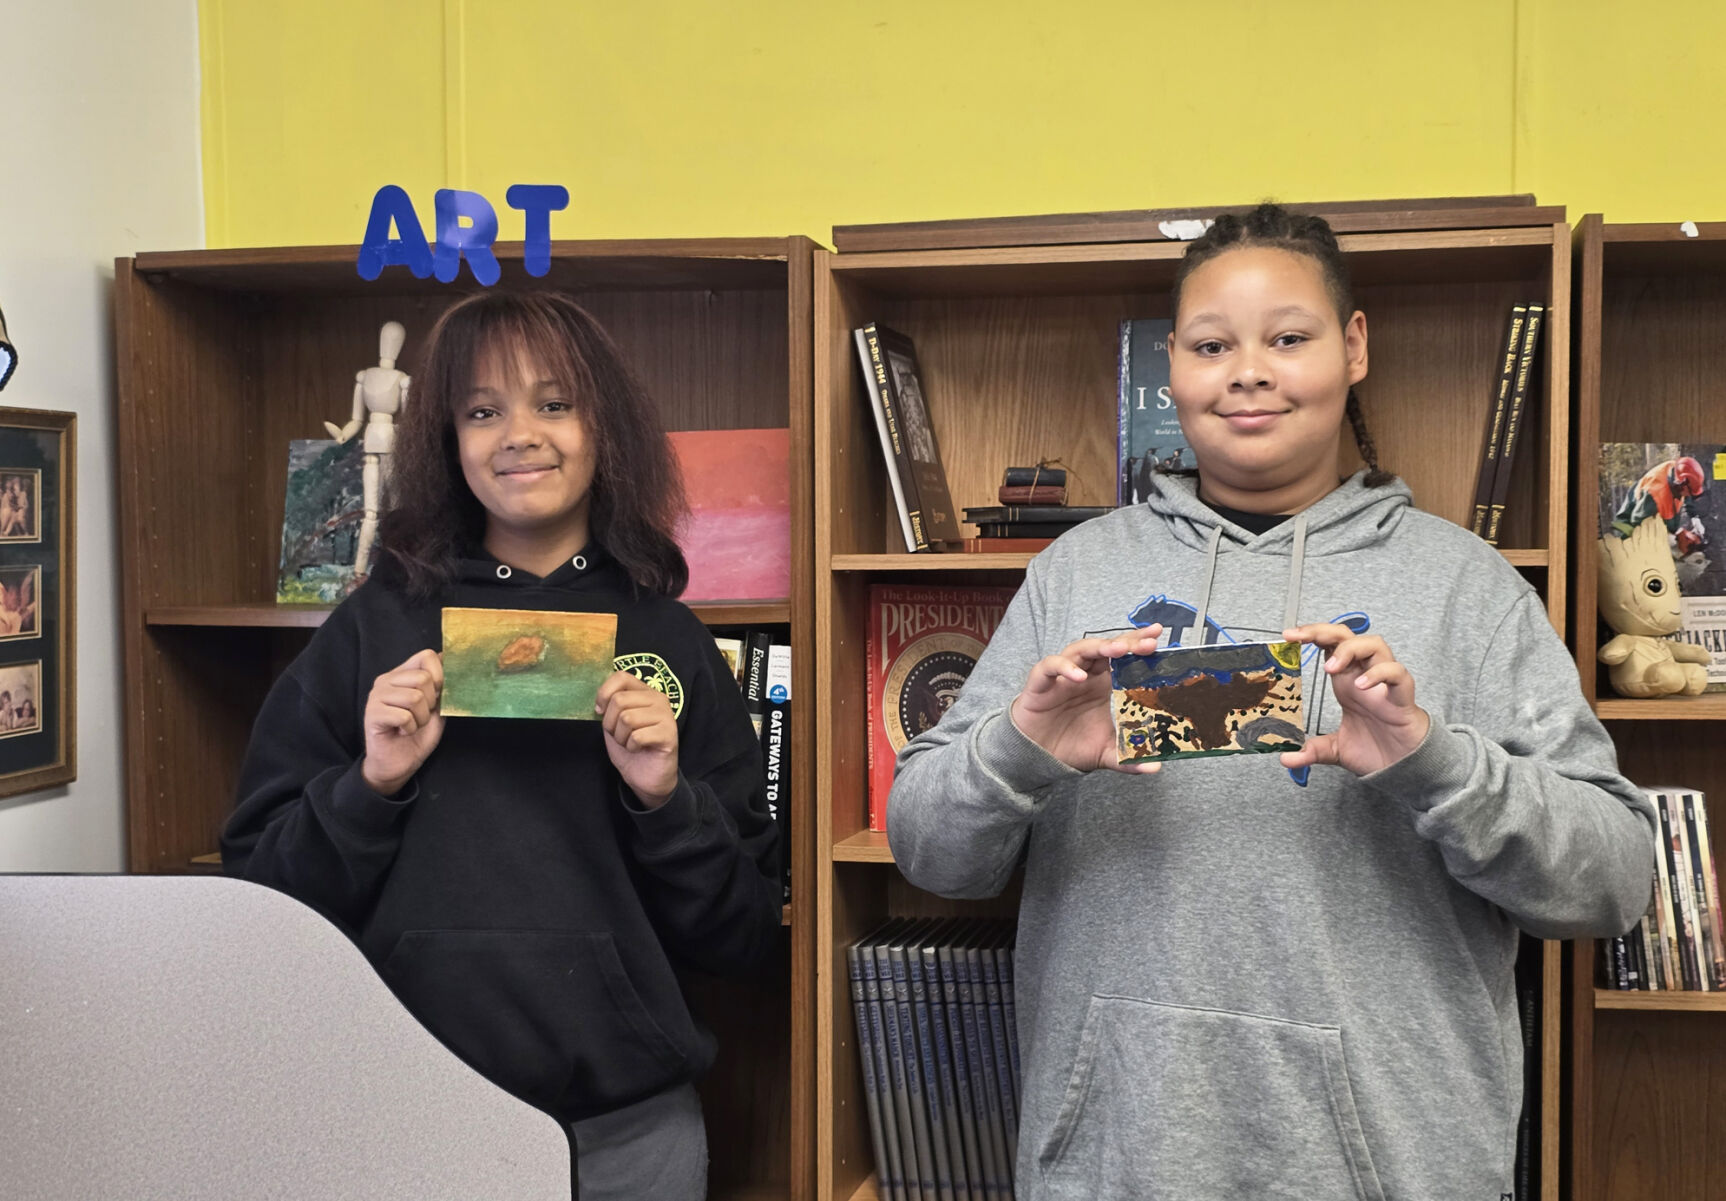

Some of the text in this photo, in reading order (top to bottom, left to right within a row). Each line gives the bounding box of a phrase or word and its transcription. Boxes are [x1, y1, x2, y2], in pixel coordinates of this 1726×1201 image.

[357, 184, 569, 286] ART
[875, 363, 886, 384] 1944
[1136, 386, 1177, 410] I S
[882, 589, 900, 600] The
[880, 602, 1003, 677] PRESIDENT
[654, 659, 679, 699] BEACH
[747, 647, 764, 701] Essential
[767, 710, 783, 781] GATEWAYS
[766, 783, 779, 801] TO
